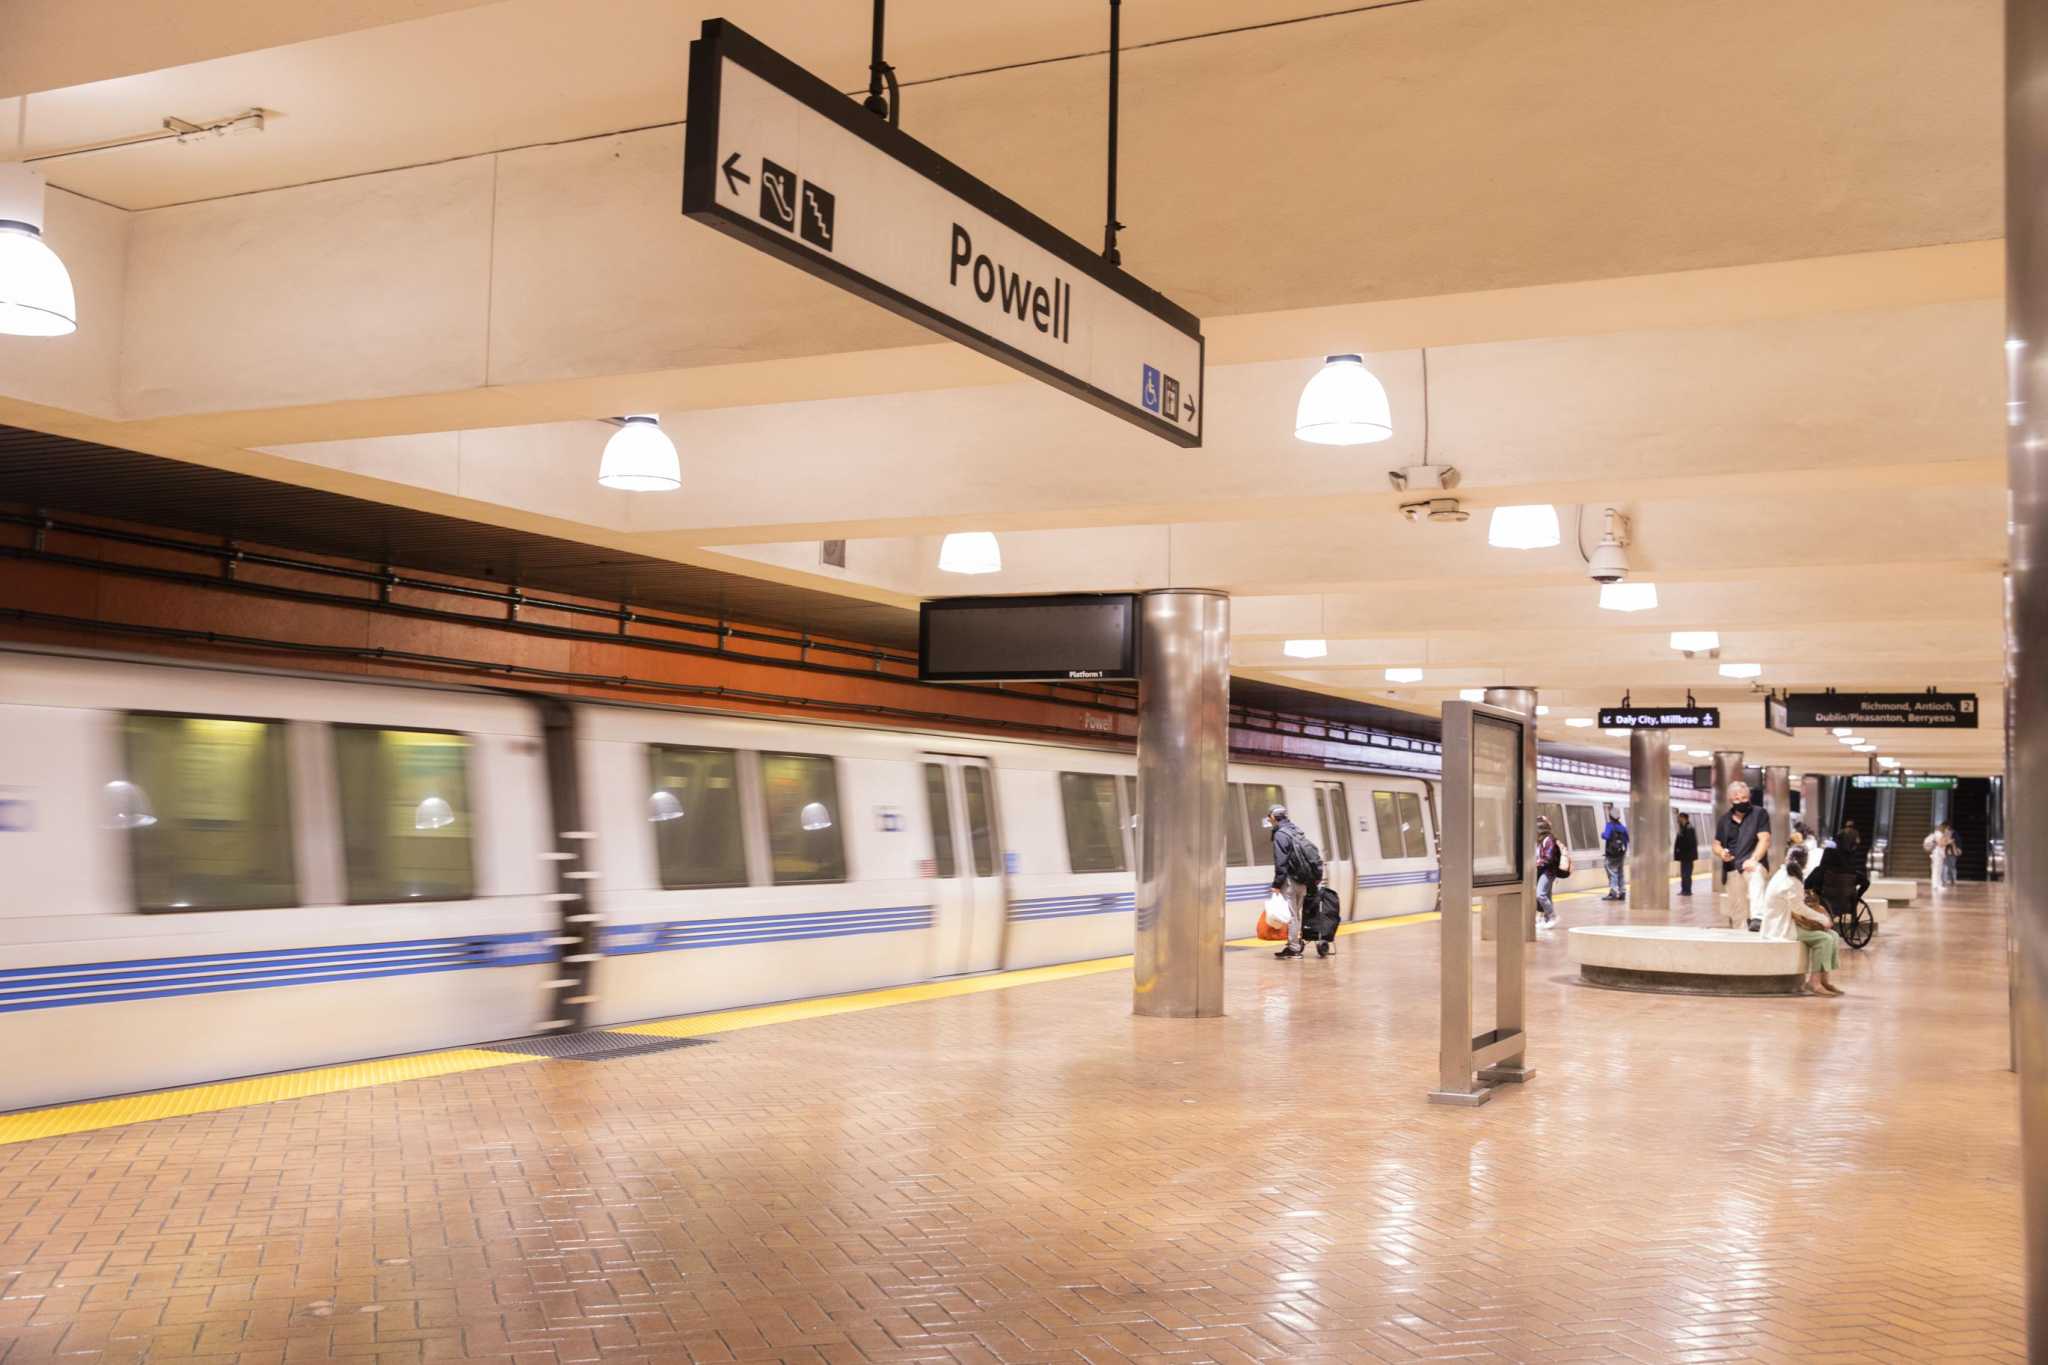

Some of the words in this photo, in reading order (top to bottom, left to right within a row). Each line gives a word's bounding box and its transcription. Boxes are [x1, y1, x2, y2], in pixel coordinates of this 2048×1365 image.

[949, 222, 1070, 344] Powell
[1861, 702, 1911, 712] Richmond,
[1914, 702, 1956, 712] Antioch,
[1615, 714, 1637, 726] Daly
[1638, 714, 1660, 726] City,
[1660, 714, 1699, 725] Millbrae
[1815, 712, 1905, 723] Dublin/Pleasanton,
[1908, 712, 1956, 724] Berryessa
